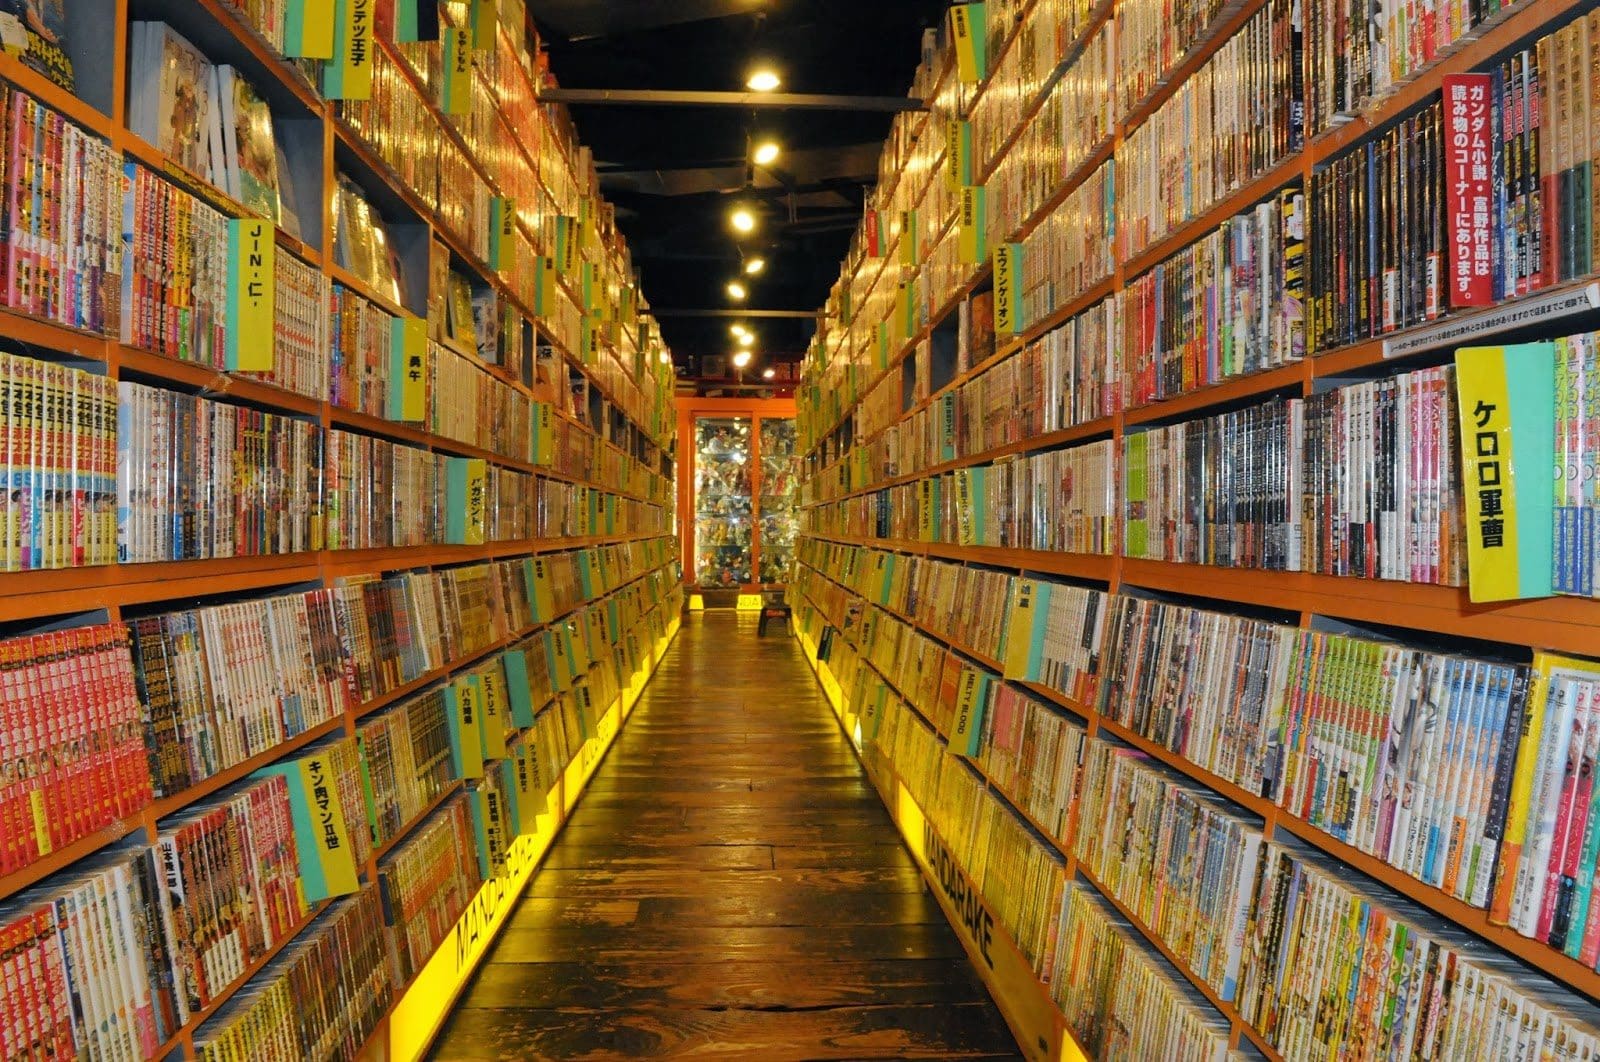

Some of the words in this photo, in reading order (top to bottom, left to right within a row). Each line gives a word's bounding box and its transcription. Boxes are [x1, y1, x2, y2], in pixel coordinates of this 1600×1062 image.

[1450, 84, 1472, 300] 読み物のコーナーにあります。
[1469, 84, 1489, 277] ガンダム小説・富野作品は
[998, 247, 1009, 329] エヴァンゲリオン
[1473, 400, 1504, 549] ケロロ軍曹
[957, 703, 969, 735] BLOOD
[964, 673, 976, 703] MELTY
